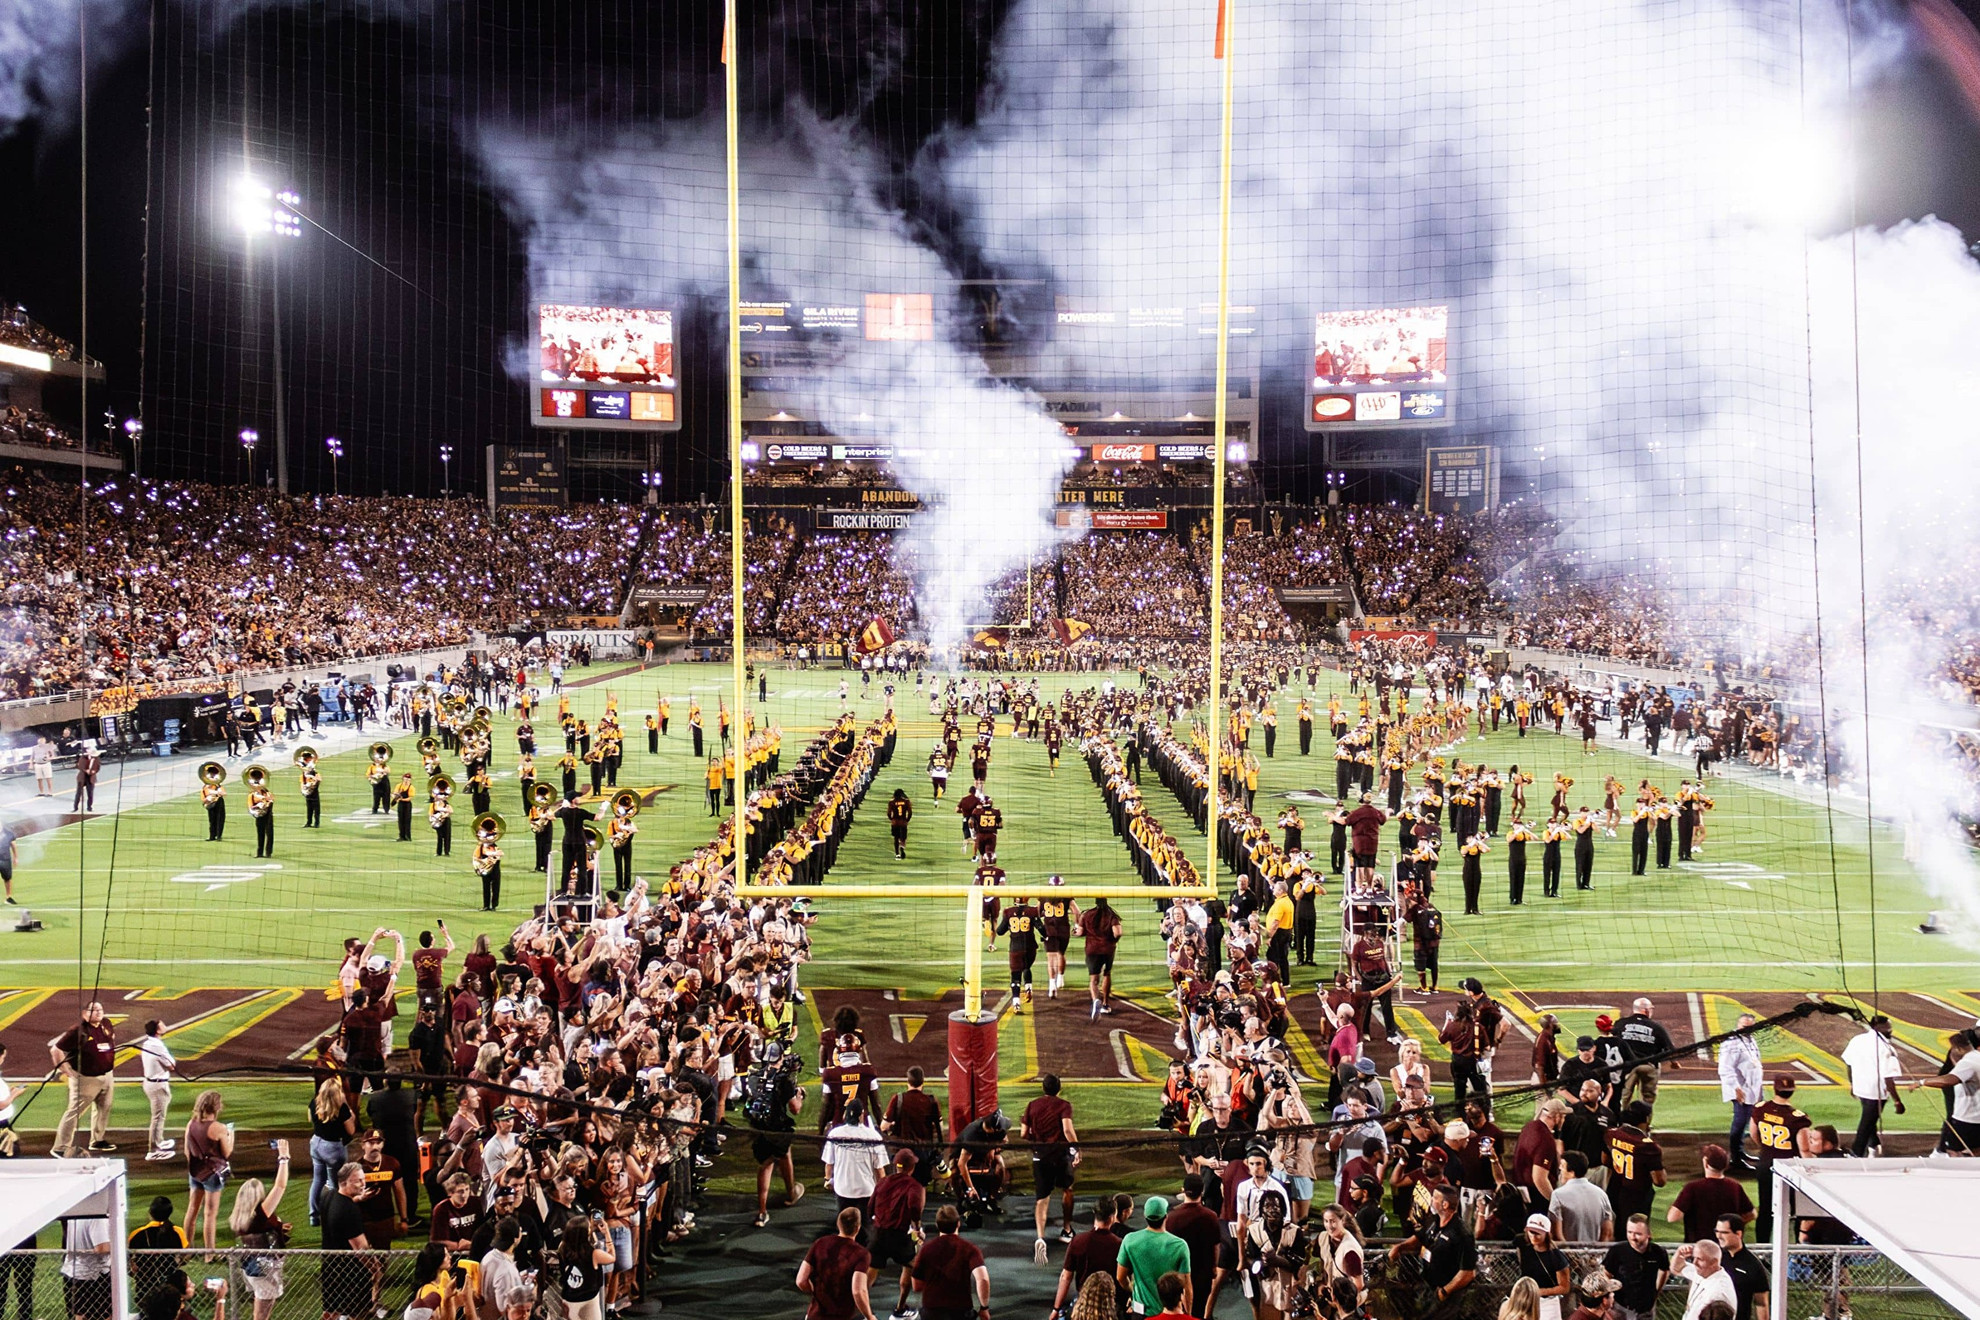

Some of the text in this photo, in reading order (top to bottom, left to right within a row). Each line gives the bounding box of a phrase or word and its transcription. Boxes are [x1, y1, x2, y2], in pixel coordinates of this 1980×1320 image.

[803, 308, 859, 316] GILA RIVER
[1058, 313, 1115, 323] POWERADE
[1101, 445, 1145, 460] Coca-Cola
[861, 491, 918, 502] ABANDON
[1094, 491, 1125, 502] HERE
[871, 515, 910, 528] PROTEIN
[550, 633, 631, 648] SPROUTS
[842, 1084, 859, 1107] 7
